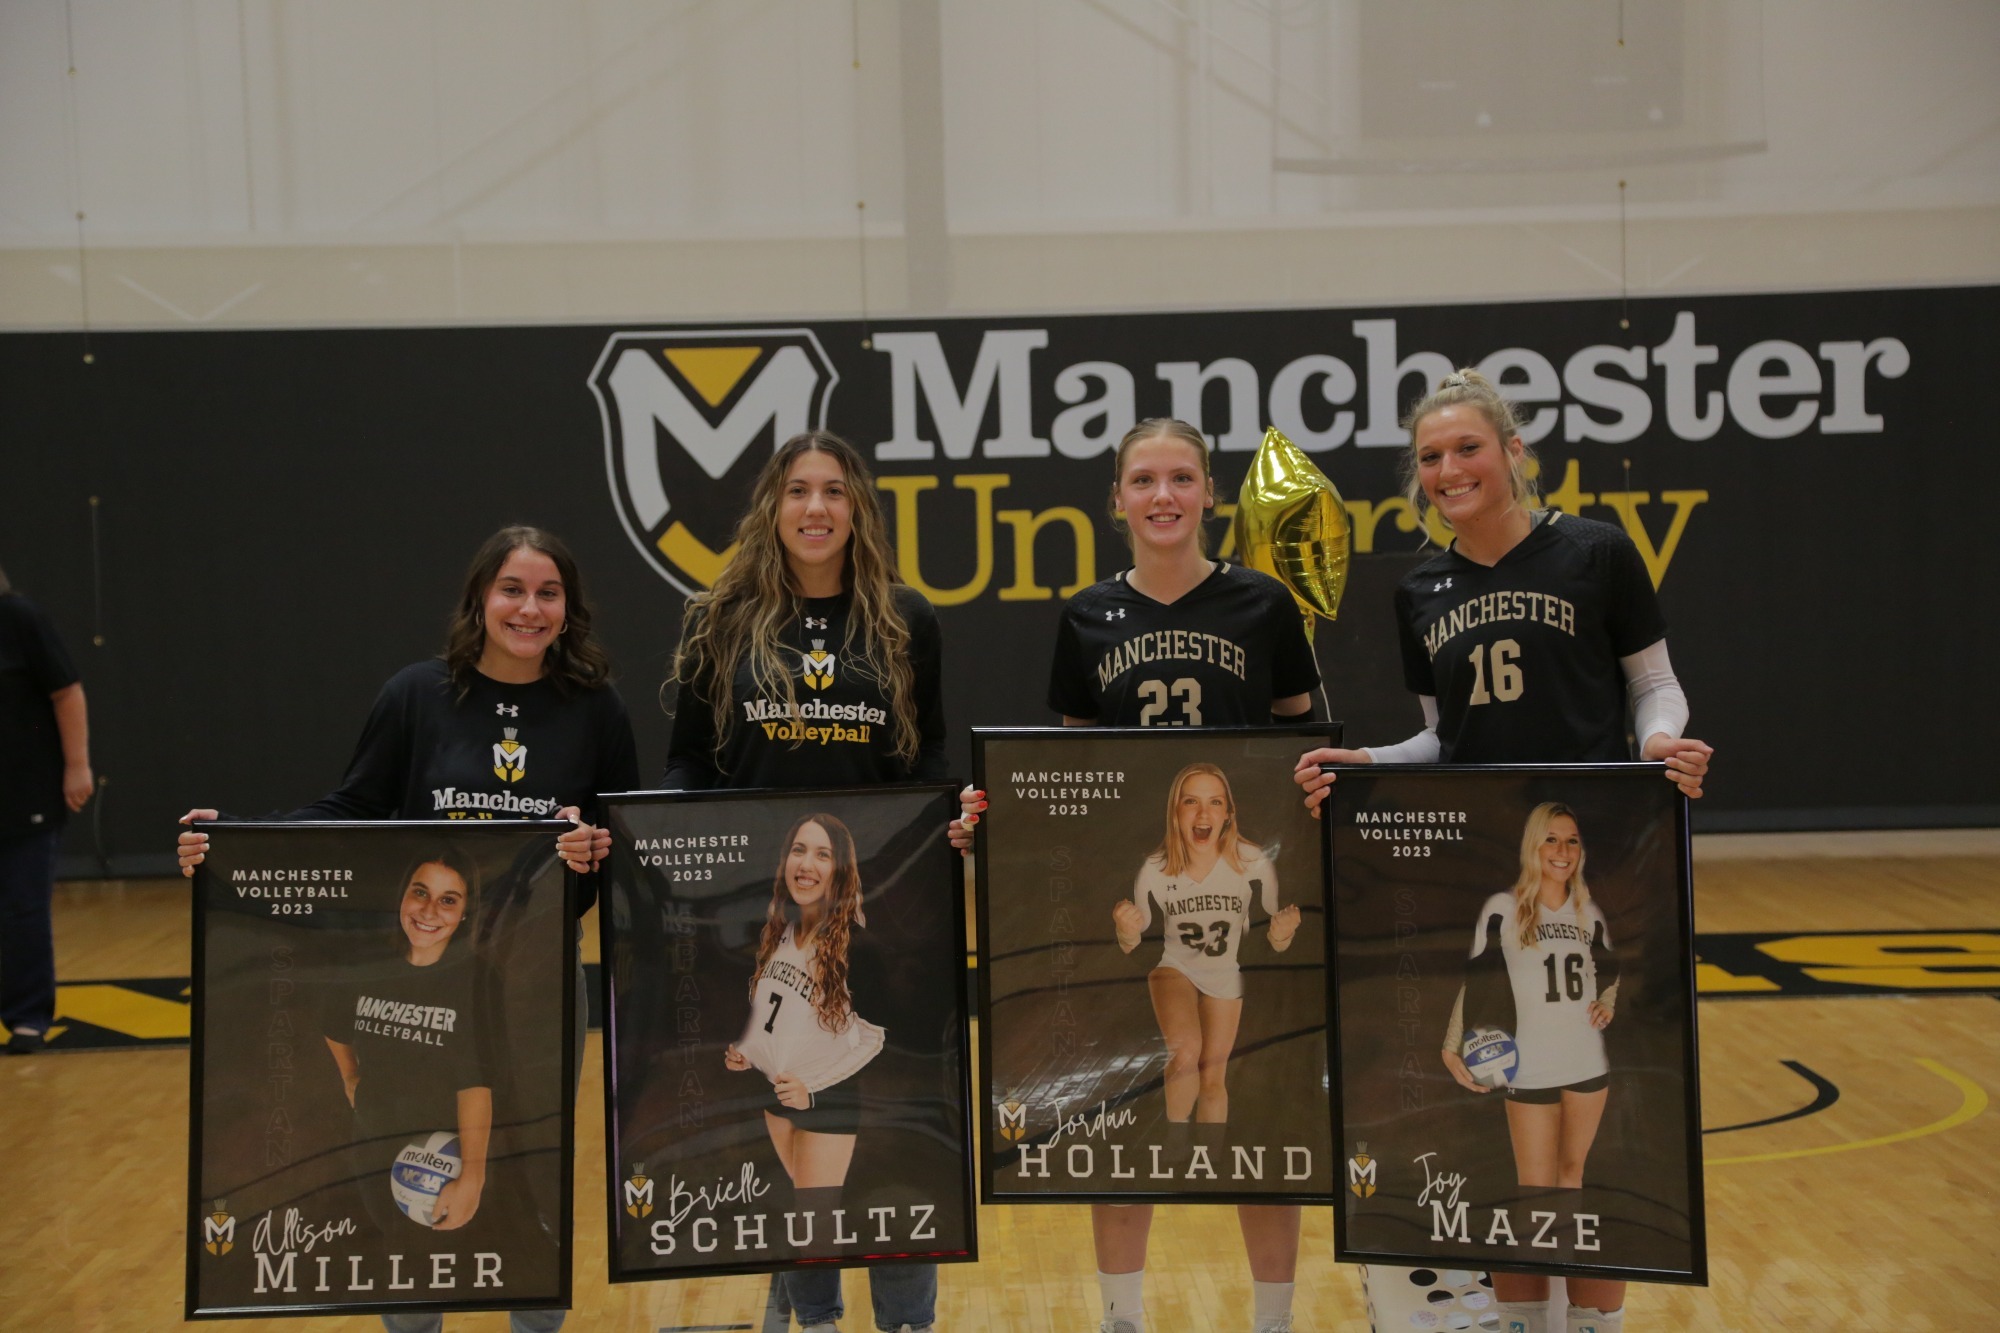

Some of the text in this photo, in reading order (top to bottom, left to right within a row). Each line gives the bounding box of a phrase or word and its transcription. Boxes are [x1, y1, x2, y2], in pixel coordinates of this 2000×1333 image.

[872, 310, 1909, 461] Manchester
[1424, 590, 1576, 662] MANCHESTER
[1098, 630, 1247, 694] MANCHESTER
[1468, 638, 1524, 706] 16
[1011, 770, 1126, 784] MANCHESTER
[1015, 786, 1122, 800] VOLLEYBALL
[1048, 803, 1089, 816] 2023
[1355, 811, 1468, 824] MANCHESTER
[634, 835, 750, 851] MANCHESTER
[1359, 828, 1464, 841] VOLLEYBALL
[1392, 845, 1432, 858] 2023
[232, 869, 354, 882] MANCHESTER
[638, 852, 747, 867] VOLLEYBALL
[673, 870, 713, 882] 2023
[236, 885, 349, 899] VOLLEYBALL
[271, 902, 314, 915] 2023
[1048, 845, 1077, 1057] SPARTAN
[1177, 921, 1230, 957] 23
[1543, 953, 1584, 1003] 16
[764, 992, 783, 1034] 7
[1394, 888, 1424, 1112] SPARTAN
[265, 945, 294, 1167] SPARTAN
[1468, 1033, 1503, 1052] molten
[1045, 1096, 1138, 1149] Jordan
[403, 1151, 454, 1174] molten
[1017, 1143, 1312, 1181] HOLLAND
[1413, 1152, 1467, 1210] Joy
[669, 1161, 771, 1227] Brielle
[649, 1204, 937, 1256] SCHULTZ
[1430, 1199, 1602, 1252] MAZE
[253, 1251, 505, 1294] MILLER
